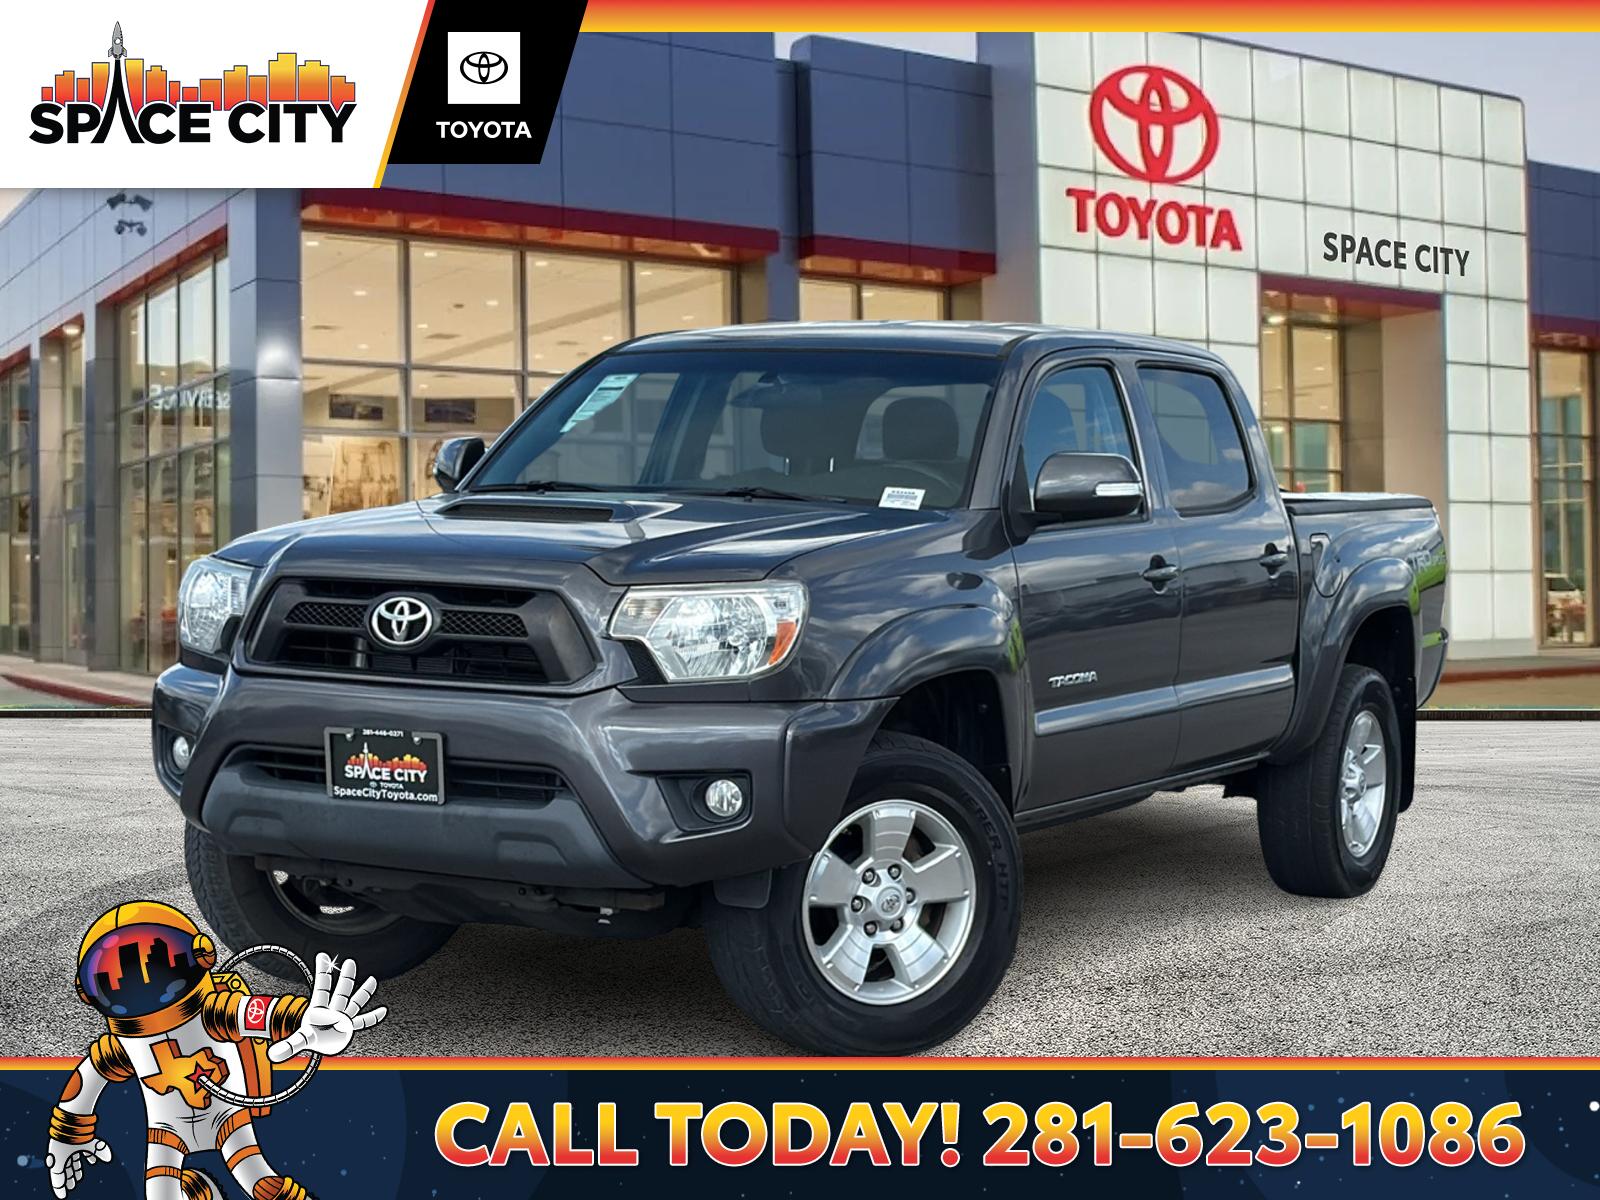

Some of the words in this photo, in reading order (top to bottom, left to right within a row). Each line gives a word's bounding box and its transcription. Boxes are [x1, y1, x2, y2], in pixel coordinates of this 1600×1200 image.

[1065, 187, 1243, 252] TOYOTA
[1322, 231, 1408, 270] SPACE
[1415, 243, 1471, 277] CITY
[1048, 670, 1098, 688] TACOMA
[345, 764, 391, 780] SPACE
[394, 768, 427, 783] CITY
[334, 786, 437, 801] SpaceCityToyota.com
